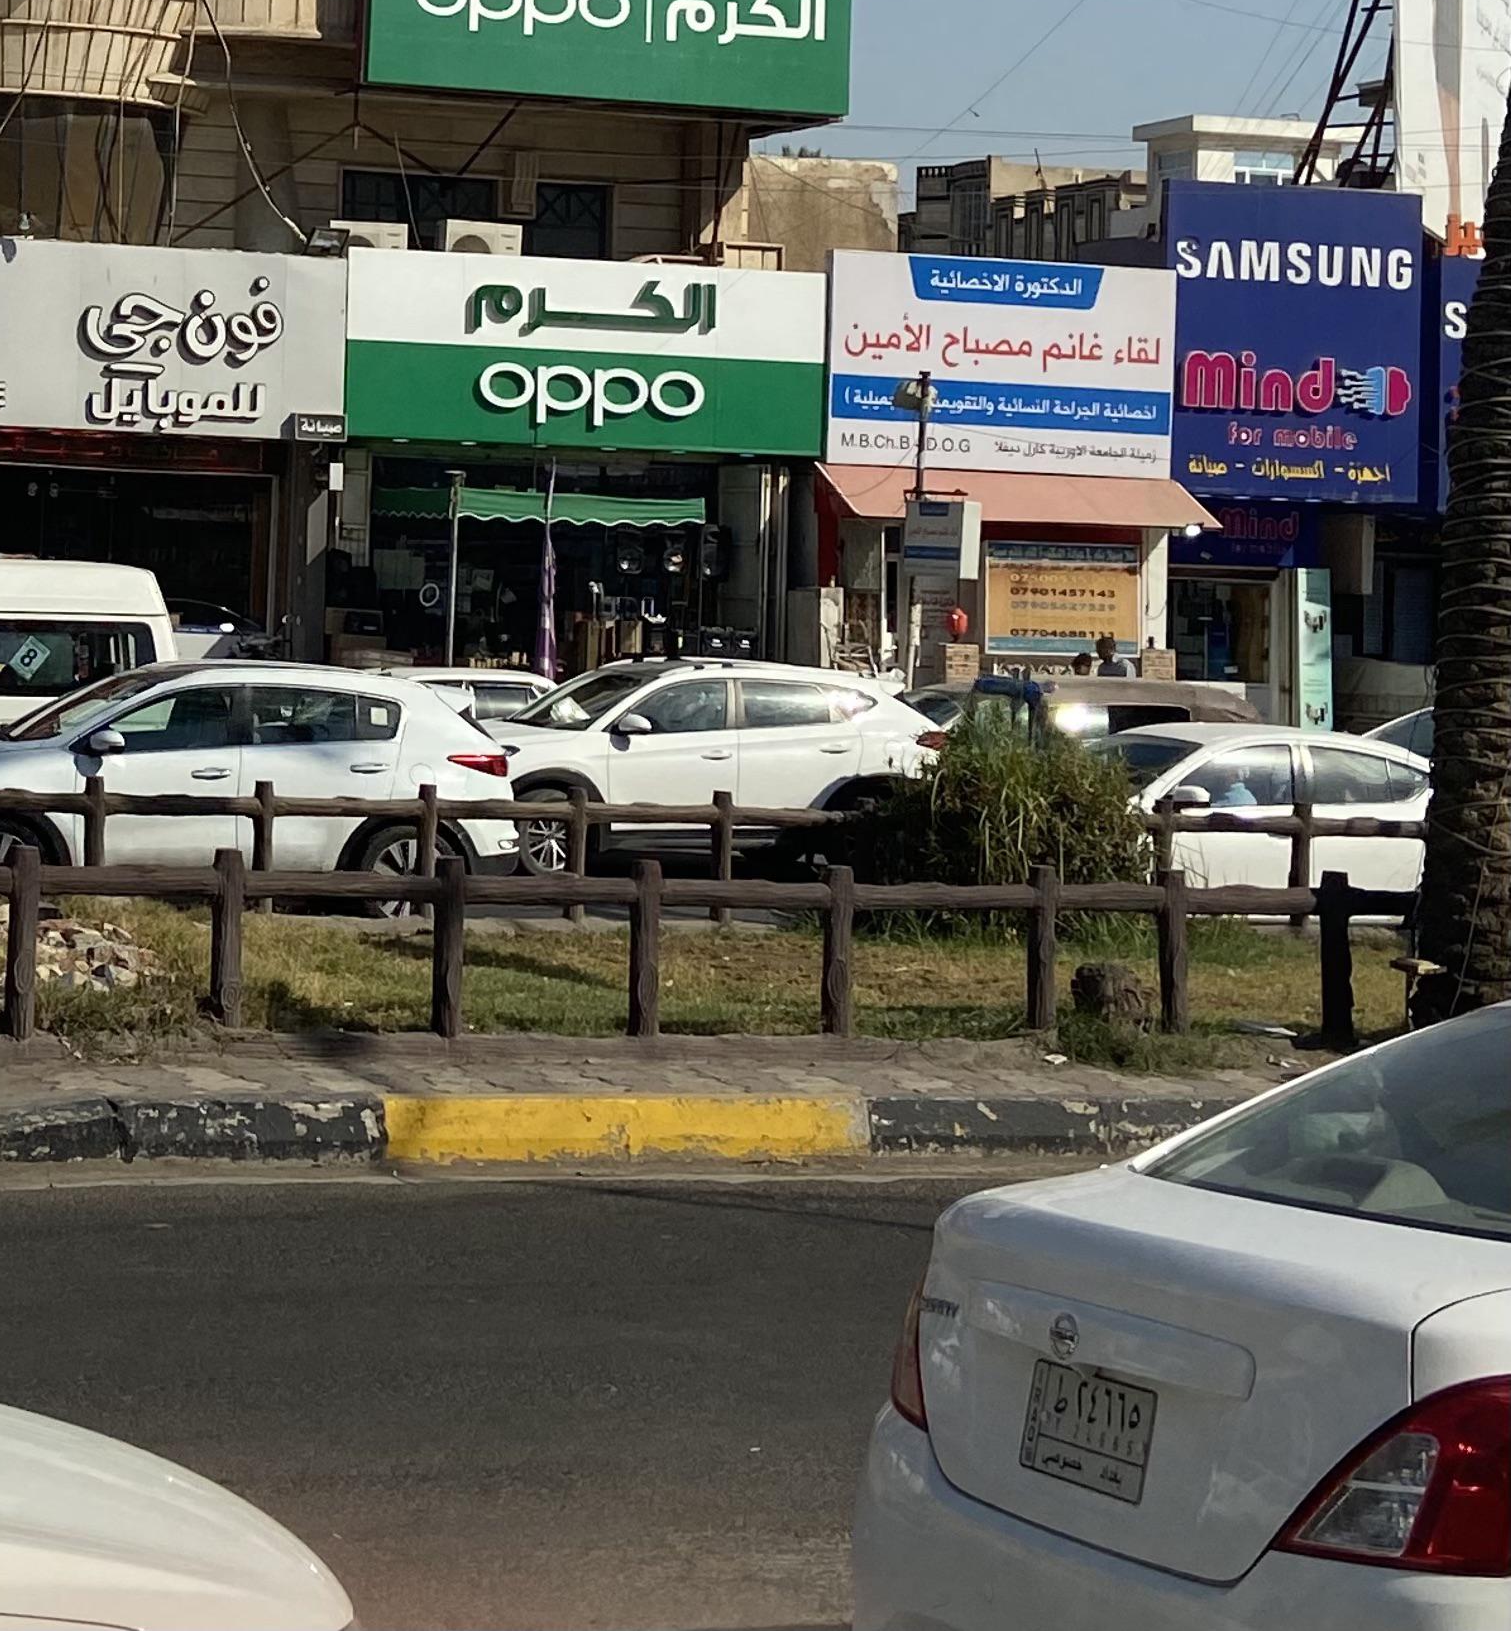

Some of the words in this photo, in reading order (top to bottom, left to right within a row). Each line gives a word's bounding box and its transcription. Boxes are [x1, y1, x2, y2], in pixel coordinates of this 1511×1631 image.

[1176, 240, 1413, 290] SAMSUNG
[930, 270, 1009, 292] الاخصائية
[1015, 277, 1082, 298] الدكتورة
[186, 276, 284, 360] فون
[470, 281, 717, 335] الكرم
[845, 313, 931, 360] الأمين
[942, 326, 1032, 368] مصباح
[1042, 332, 1102, 372] غانم
[1114, 334, 1161, 365] لقاء
[480, 362, 705, 427] oppo
[1184, 350, 1335, 413] Mind
[92, 378, 266, 430] للموبايل
[931, 394, 993, 415] والتقويمي
[997, 398, 1050, 415] النسائية
[1054, 400, 1100, 417] الجراحة
[1103, 404, 1157, 420] اخصائية
[301, 420, 342, 436] صيانة
[1228, 421, 1263, 446] for
[1273, 425, 1358, 451] mobile
[20, 649, 37, 667] 8
